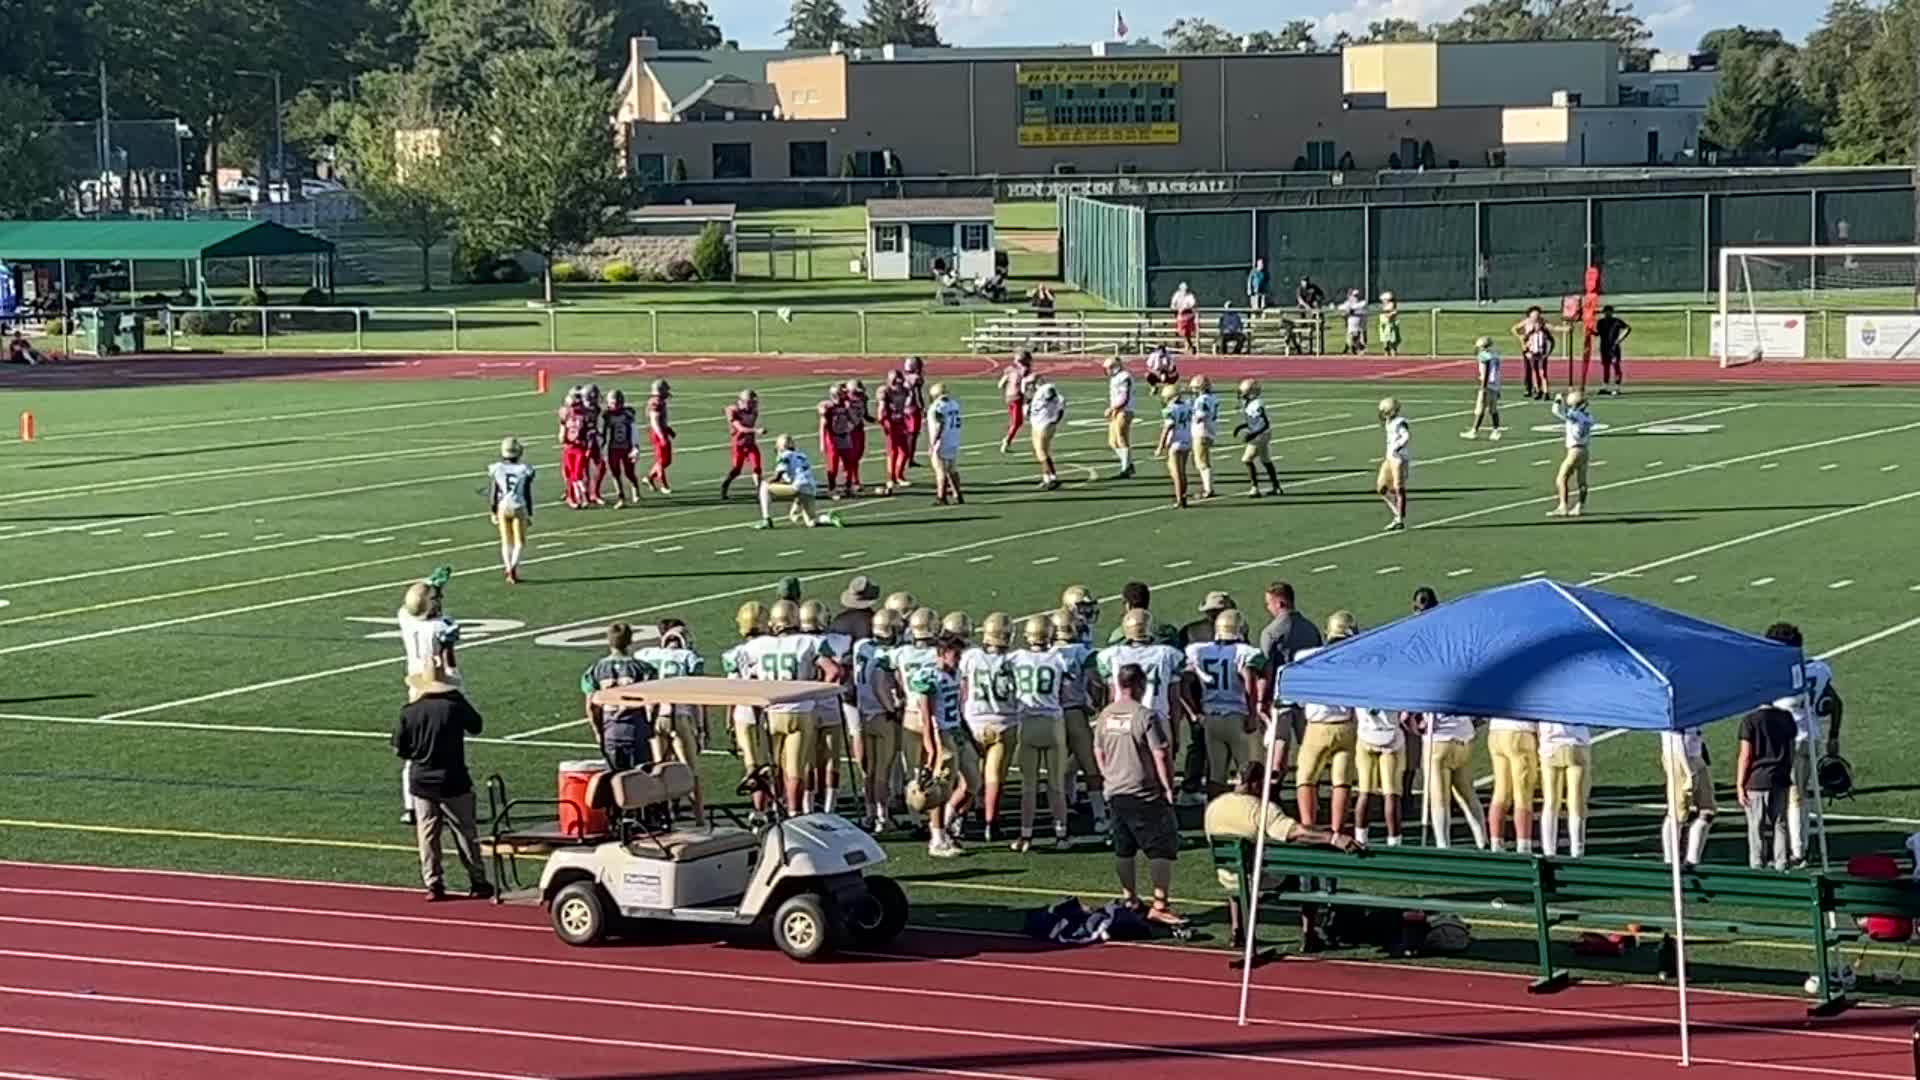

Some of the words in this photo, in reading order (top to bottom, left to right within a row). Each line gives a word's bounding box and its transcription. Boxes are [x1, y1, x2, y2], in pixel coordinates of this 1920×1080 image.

[1007, 181, 1115, 197] HENDRICKEN
[1147, 180, 1225, 194] BASEBALL
[761, 652, 800, 681] 99
[1016, 664, 1056, 694] 88
[1203, 657, 1229, 690] 51
